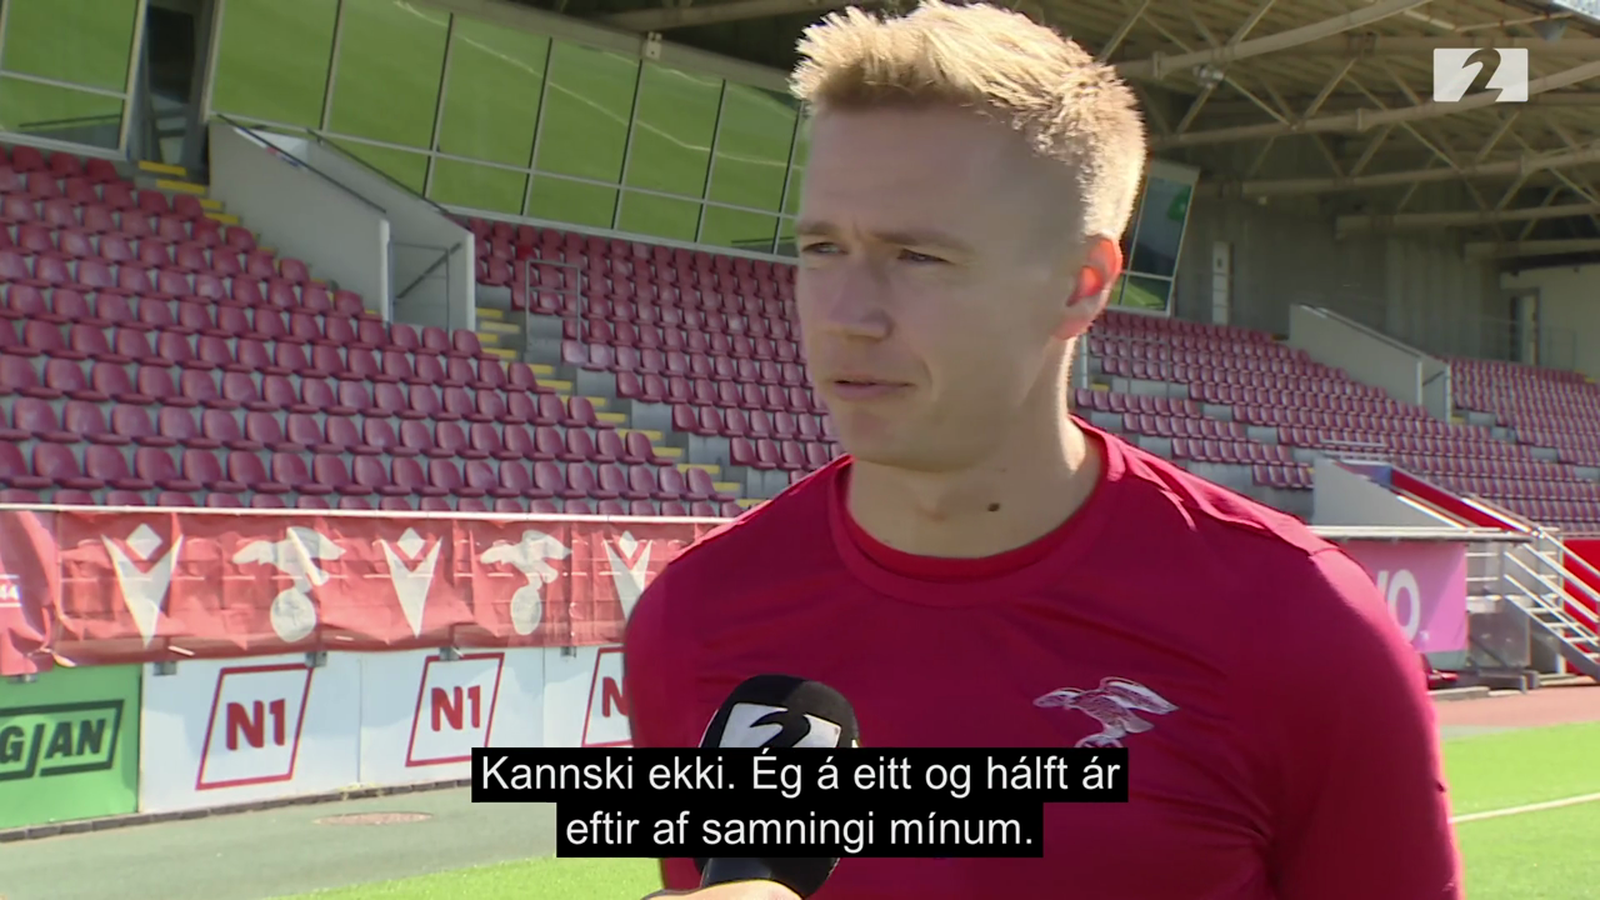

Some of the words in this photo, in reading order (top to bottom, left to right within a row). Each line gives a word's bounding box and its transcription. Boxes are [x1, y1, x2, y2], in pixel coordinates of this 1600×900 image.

[431, 685, 481, 731] N1
[602, 676, 629, 718] N
[226, 699, 286, 750] N1
